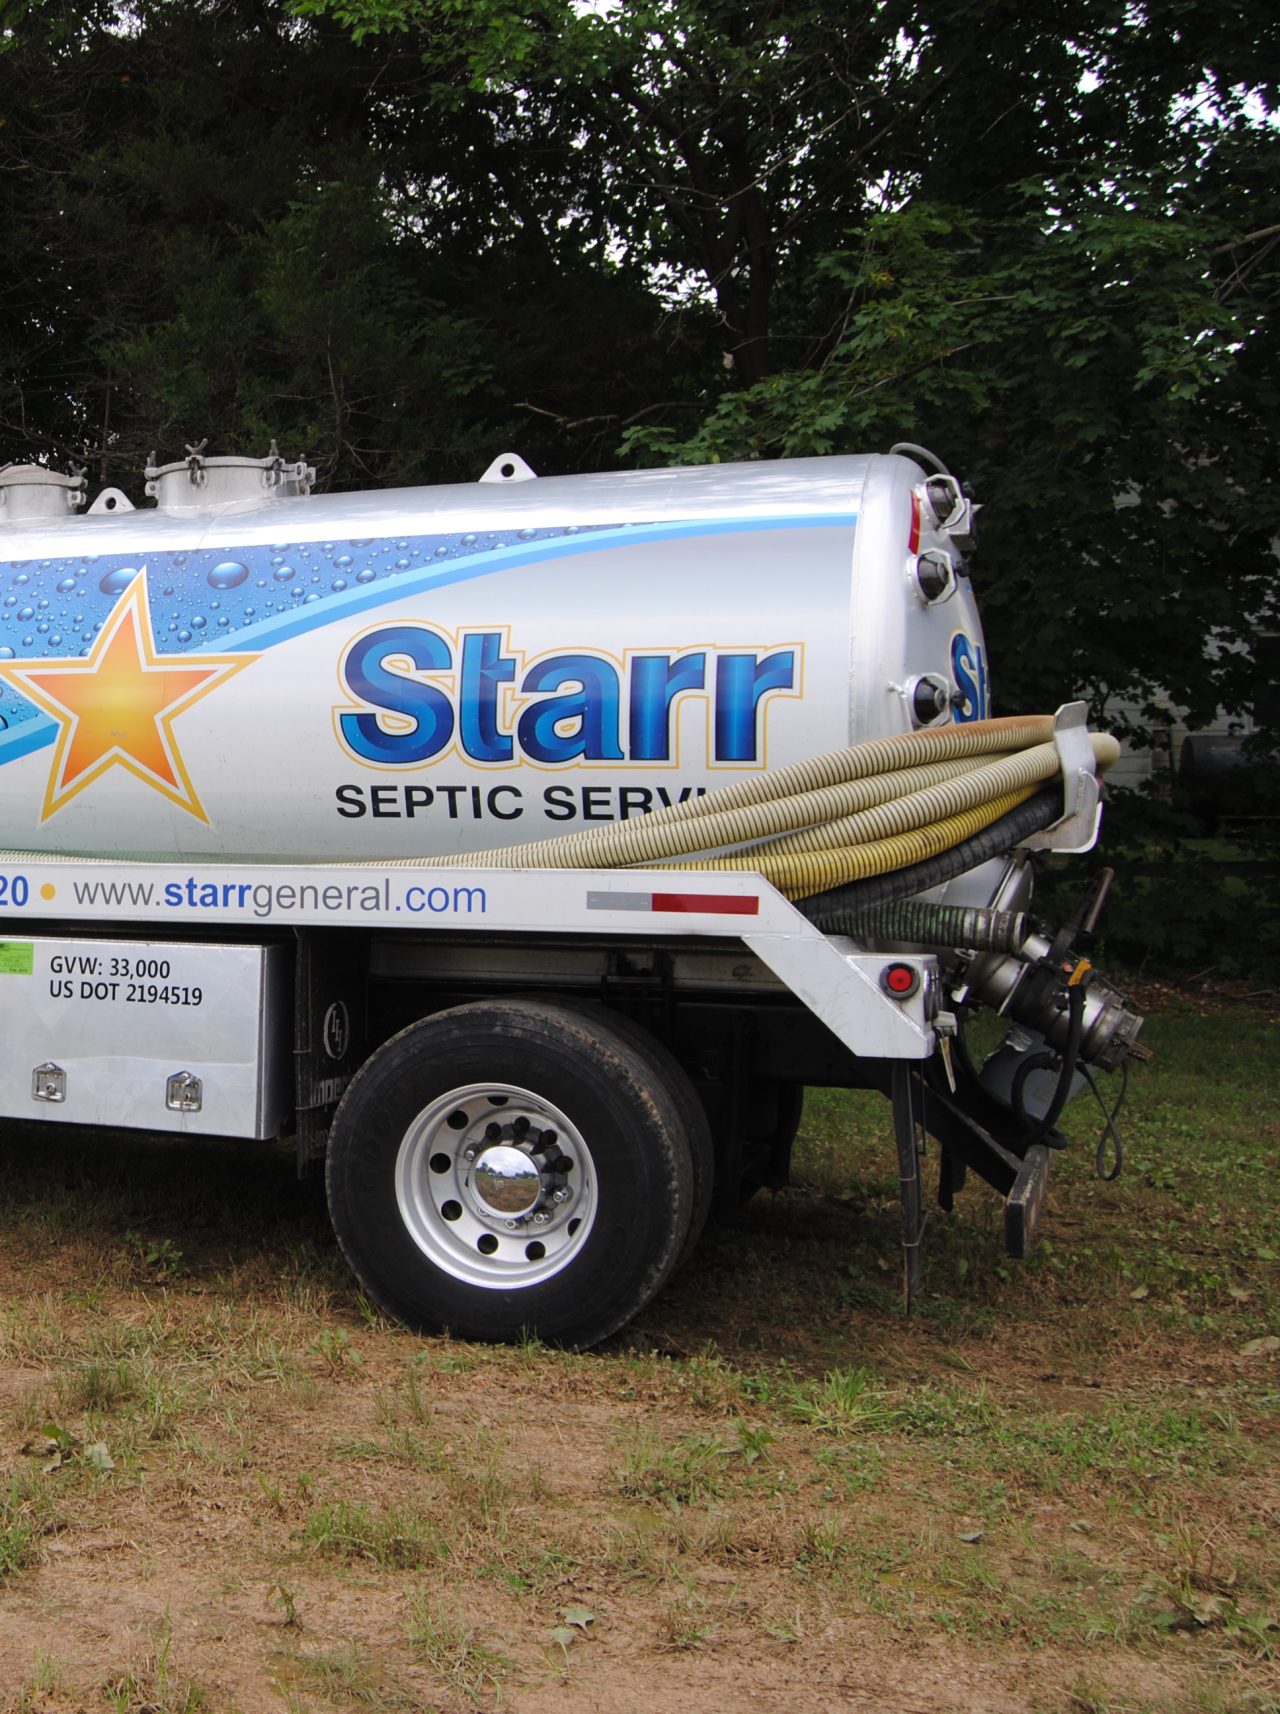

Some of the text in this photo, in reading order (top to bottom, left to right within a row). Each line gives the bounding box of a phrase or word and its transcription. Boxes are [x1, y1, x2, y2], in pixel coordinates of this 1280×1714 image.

[334, 621, 803, 768] Starr
[335, 784, 707, 821] SEPTIC SERV
[73, 876, 488, 918] www.starrgeneral.com
[50, 955, 103, 976] GVW:
[110, 958, 171, 980] 33,000
[49, 980, 203, 1006] US DOT 2194519
